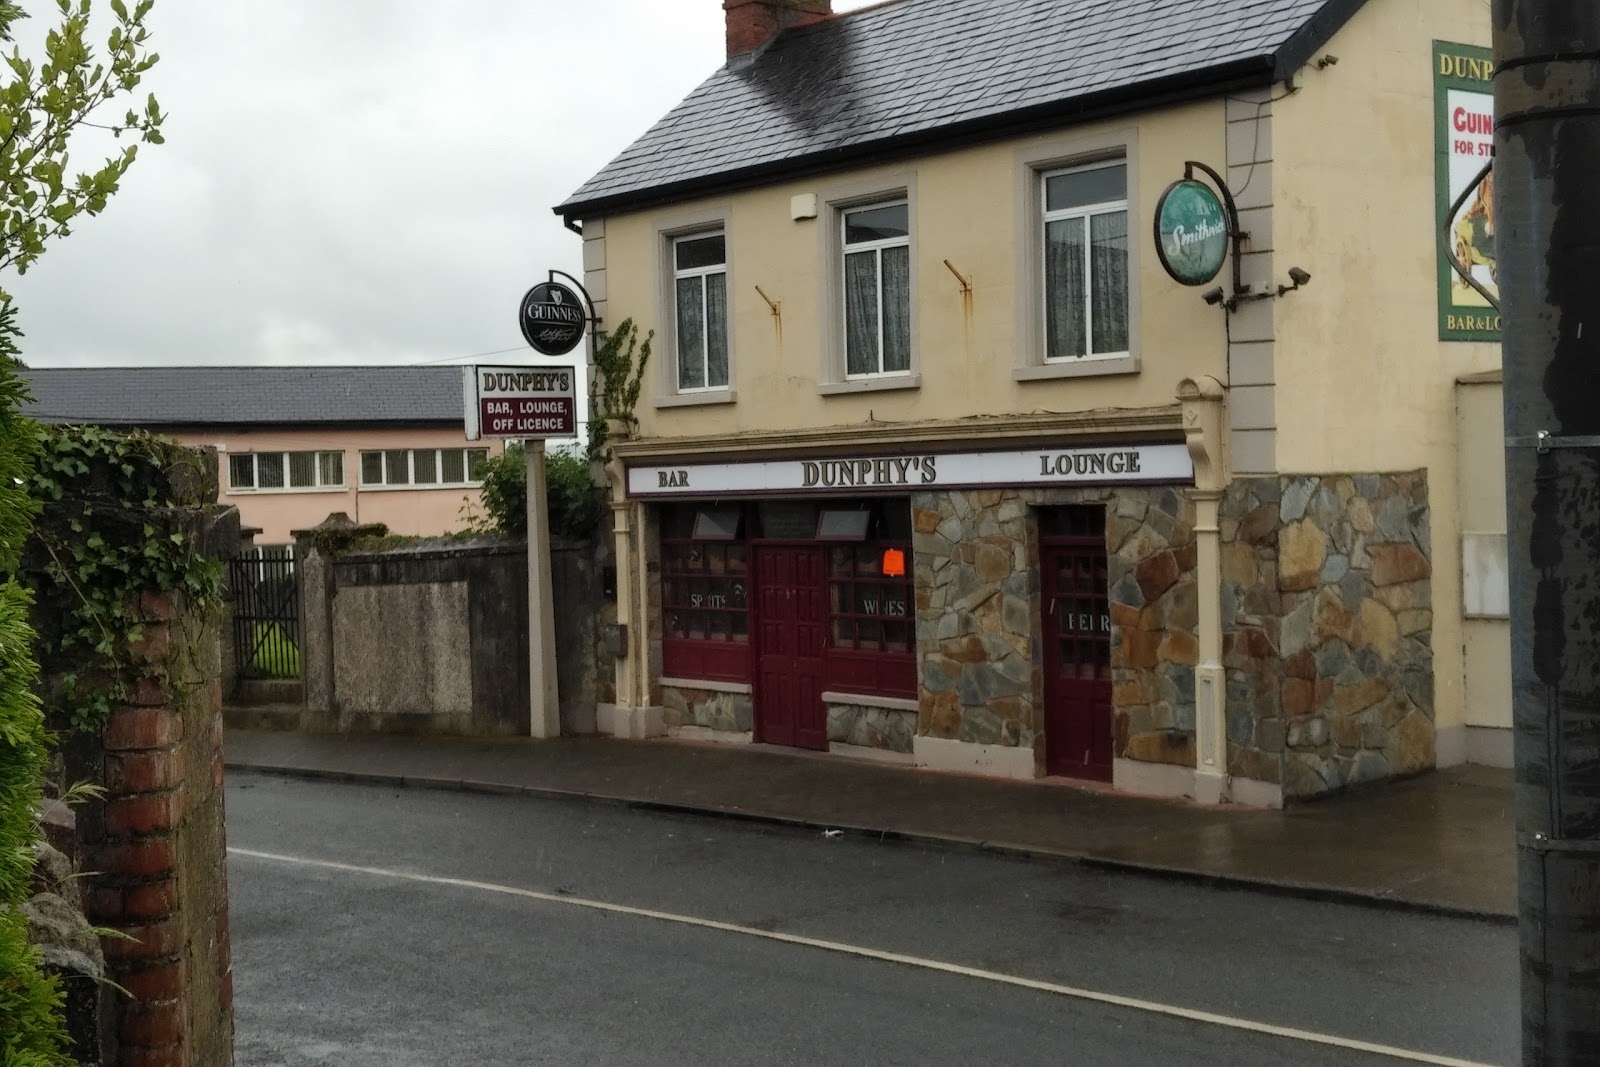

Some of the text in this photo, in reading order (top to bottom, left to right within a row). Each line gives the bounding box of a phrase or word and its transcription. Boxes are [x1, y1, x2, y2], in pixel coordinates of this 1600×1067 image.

[1454, 139, 1474, 155] FOR
[527, 303, 582, 322] GUINNESS
[483, 372, 570, 392] DUNPHY'S
[487, 401, 568, 416] BAR, LOUNGE,
[492, 417, 564, 431] OFF LICENCE
[658, 451, 1141, 488] BAR DUNPHY'S LOUNGE
